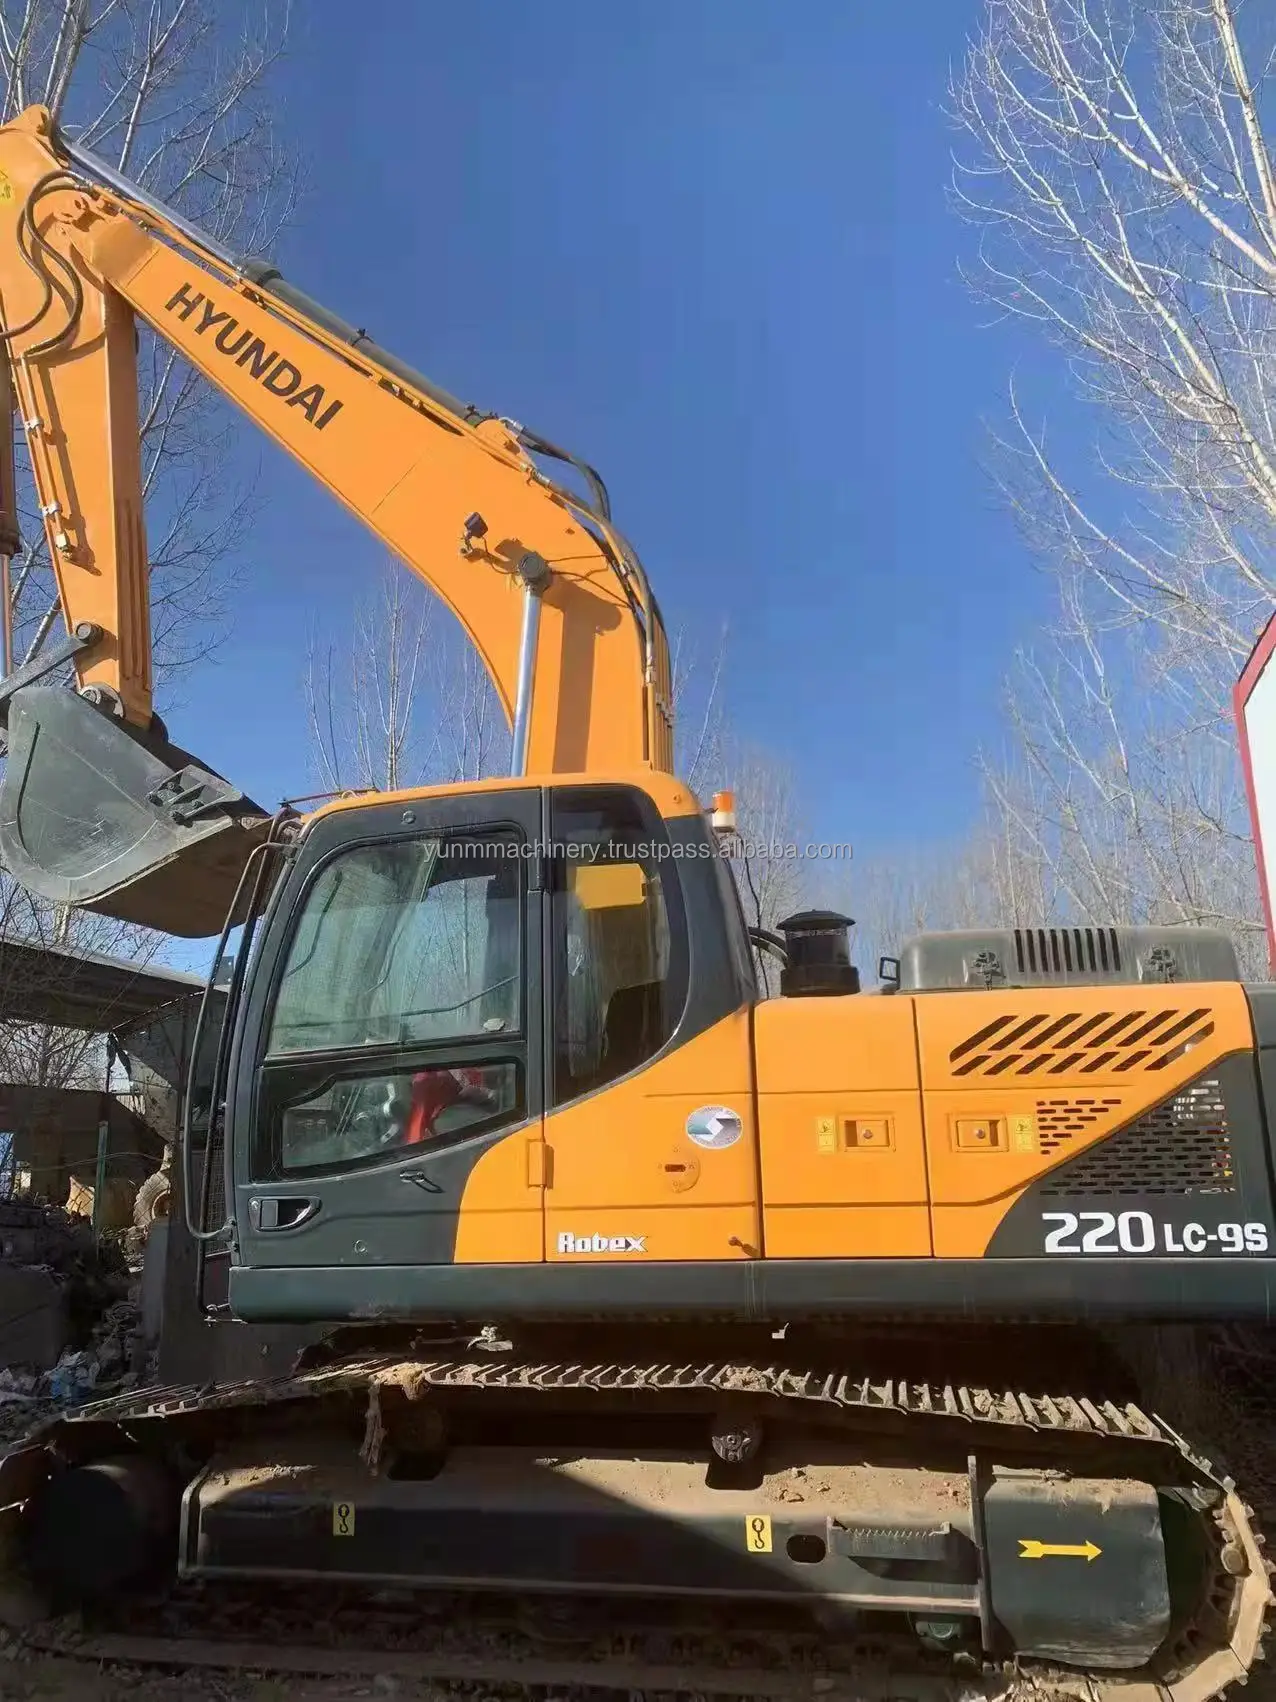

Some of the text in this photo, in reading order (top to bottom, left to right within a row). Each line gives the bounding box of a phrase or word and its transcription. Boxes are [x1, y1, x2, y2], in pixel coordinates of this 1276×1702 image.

[165, 280, 345, 431] HYUNDAI
[557, 1231, 648, 1253] Robex
[1041, 1210, 1269, 1254] 220 LC-9S
